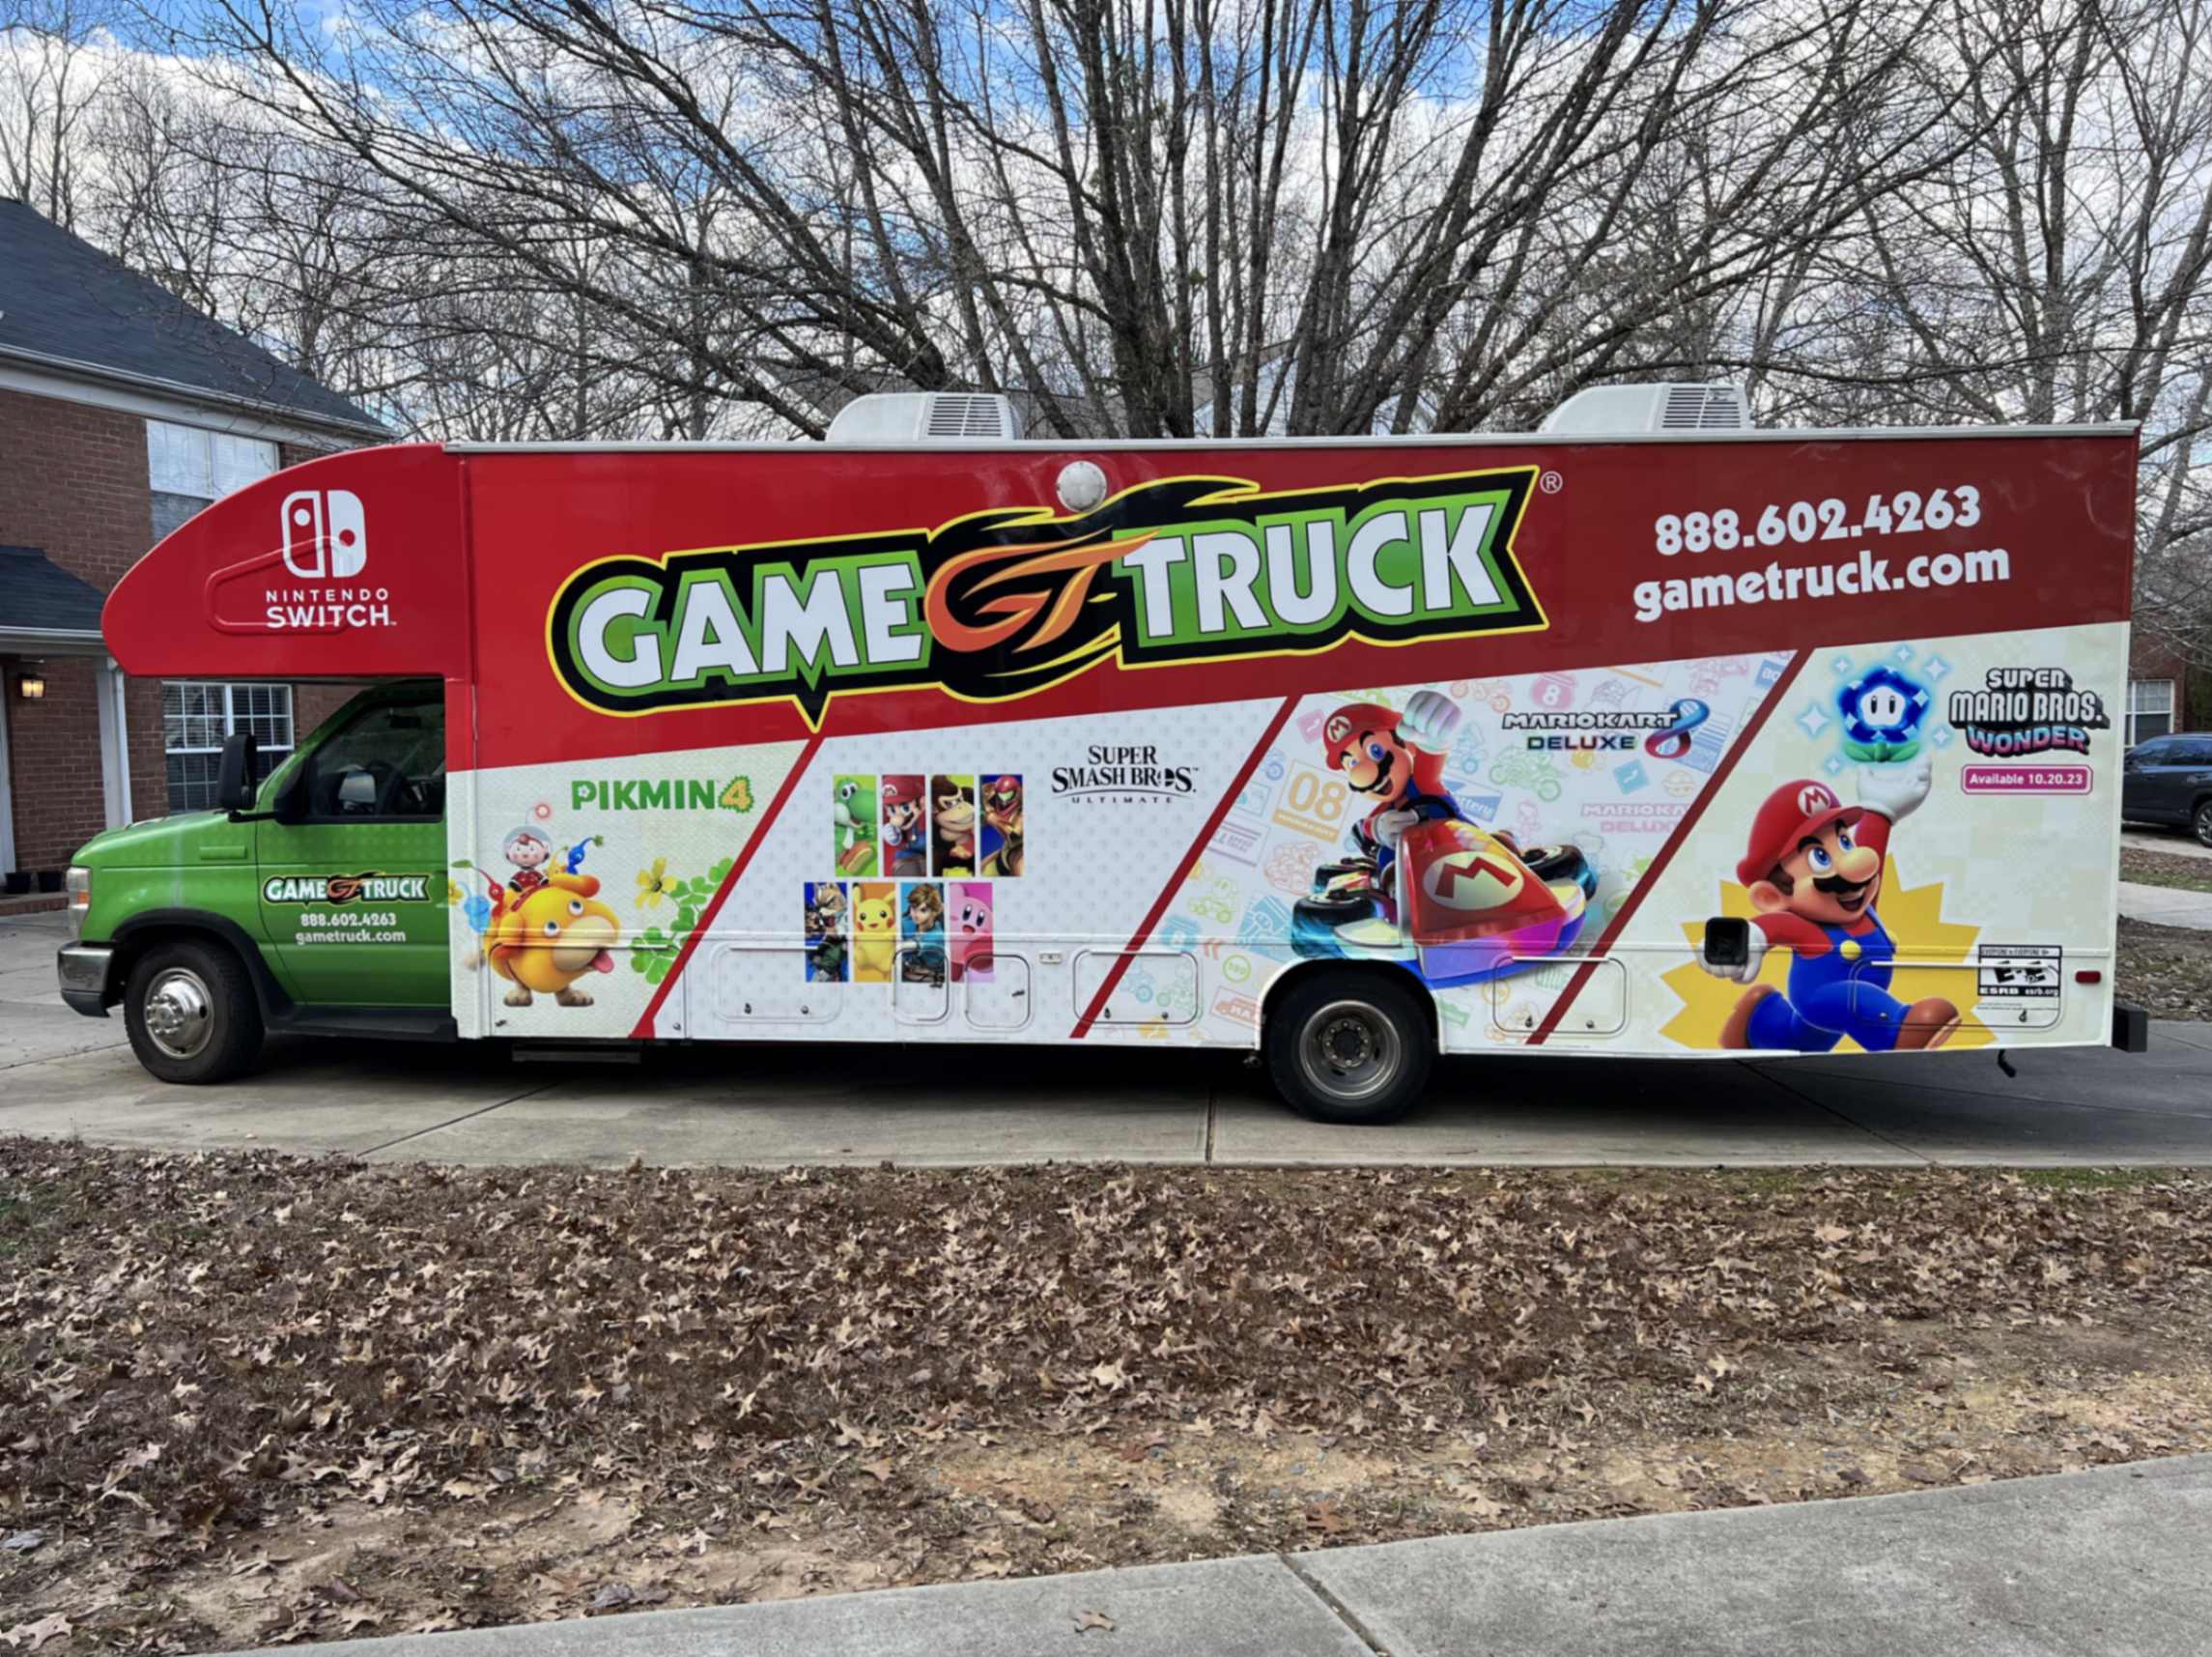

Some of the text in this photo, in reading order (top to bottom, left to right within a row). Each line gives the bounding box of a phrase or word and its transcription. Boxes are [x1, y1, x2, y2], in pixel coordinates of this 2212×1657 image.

[1655, 485, 1981, 557] 888.602.4263
[266, 587, 388, 602] NINTENDO
[579, 562, 923, 688] GAME
[1121, 502, 1504, 639] TRUCK
[1633, 549, 2009, 622] gametruck.com
[266, 604, 389, 628] SWITCH
[1988, 670, 2065, 689] SUPER
[1950, 692, 2103, 723] MARIO BROS.
[1527, 735, 1635, 751] DELUXE
[1967, 726, 2087, 755] WONDER
[1088, 745, 1158, 765] SUPER
[1051, 767, 1125, 793] SMASH
[1970, 774, 2084, 785] Available 10.20.23
[572, 775, 754, 814] PIKMIN 4
[1289, 772, 1347, 821] 08
[1600, 822, 1678, 834] DELUX
[266, 878, 327, 900] GAME
[361, 877, 426, 899] TRUCK
[300, 913, 397, 928] 888.602.4263
[295, 929, 406, 946] gametruck.com
